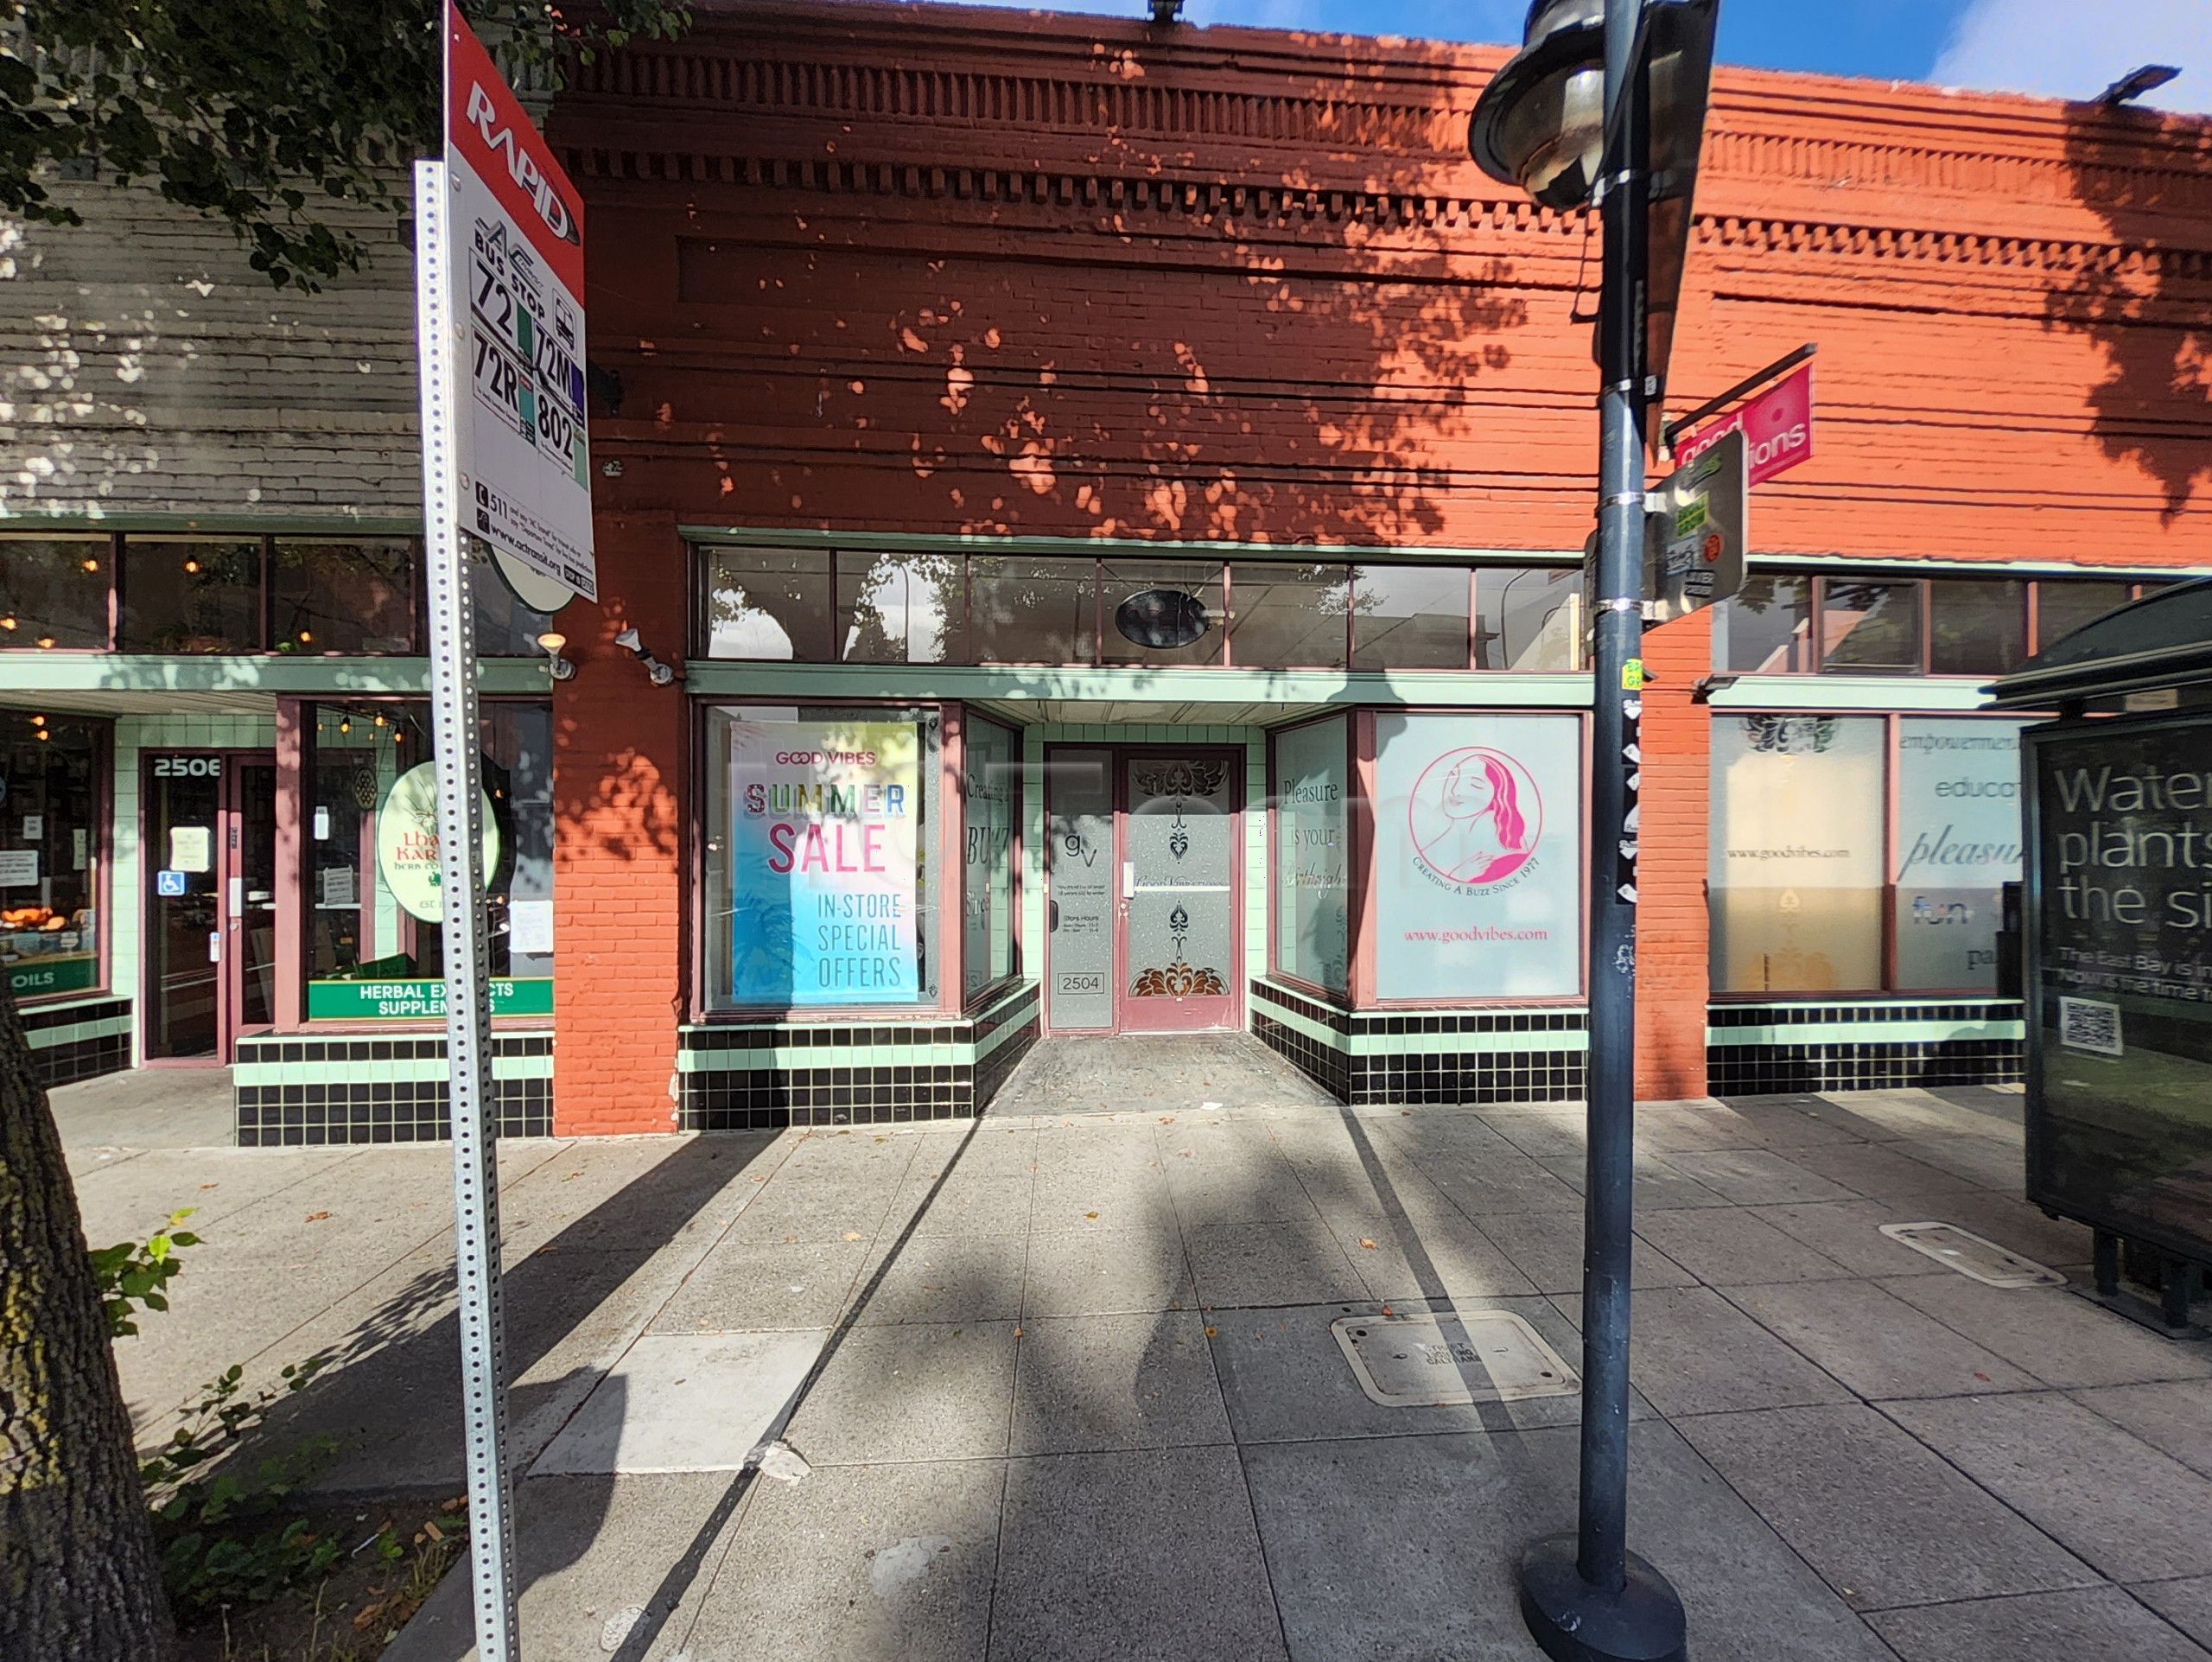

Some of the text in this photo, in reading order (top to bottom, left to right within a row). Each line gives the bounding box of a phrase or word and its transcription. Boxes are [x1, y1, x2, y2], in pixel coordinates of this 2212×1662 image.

[467, 80, 568, 239] RAPID
[475, 228, 545, 320] BUS STOP
[477, 258, 513, 338] 72
[474, 331, 518, 412] 72R
[537, 325, 572, 398] 72M
[538, 394, 574, 461] 802
[490, 494, 508, 519] 511
[776, 751, 876, 765] GOOD VIBES
[746, 783, 905, 813] SUMMER
[1284, 779, 1338, 805] Pleasure
[1935, 775, 2020, 797] educa
[768, 823, 886, 873] SALE
[1304, 828, 1335, 851] your
[1897, 824, 2023, 882] pleasu
[1413, 856, 1452, 891] CREATING
[1453, 886, 1462, 895] A
[1520, 856, 1540, 878] 1977
[817, 894, 901, 918] IN-STORE
[1912, 895, 1969, 925] fun
[2056, 874, 2146, 924] the
[817, 924, 901, 952] SPECIAL
[1404, 926, 1548, 943] www.goodvibes.com
[817, 957, 901, 987] OFFERS
[2096, 951, 2131, 967] East
[2135, 955, 2171, 975] Bay
[2175, 958, 2193, 976] is
[11, 971, 54, 988] OILS
[360, 984, 425, 1000] HERBAL
[1063, 977, 1099, 990] 2504
